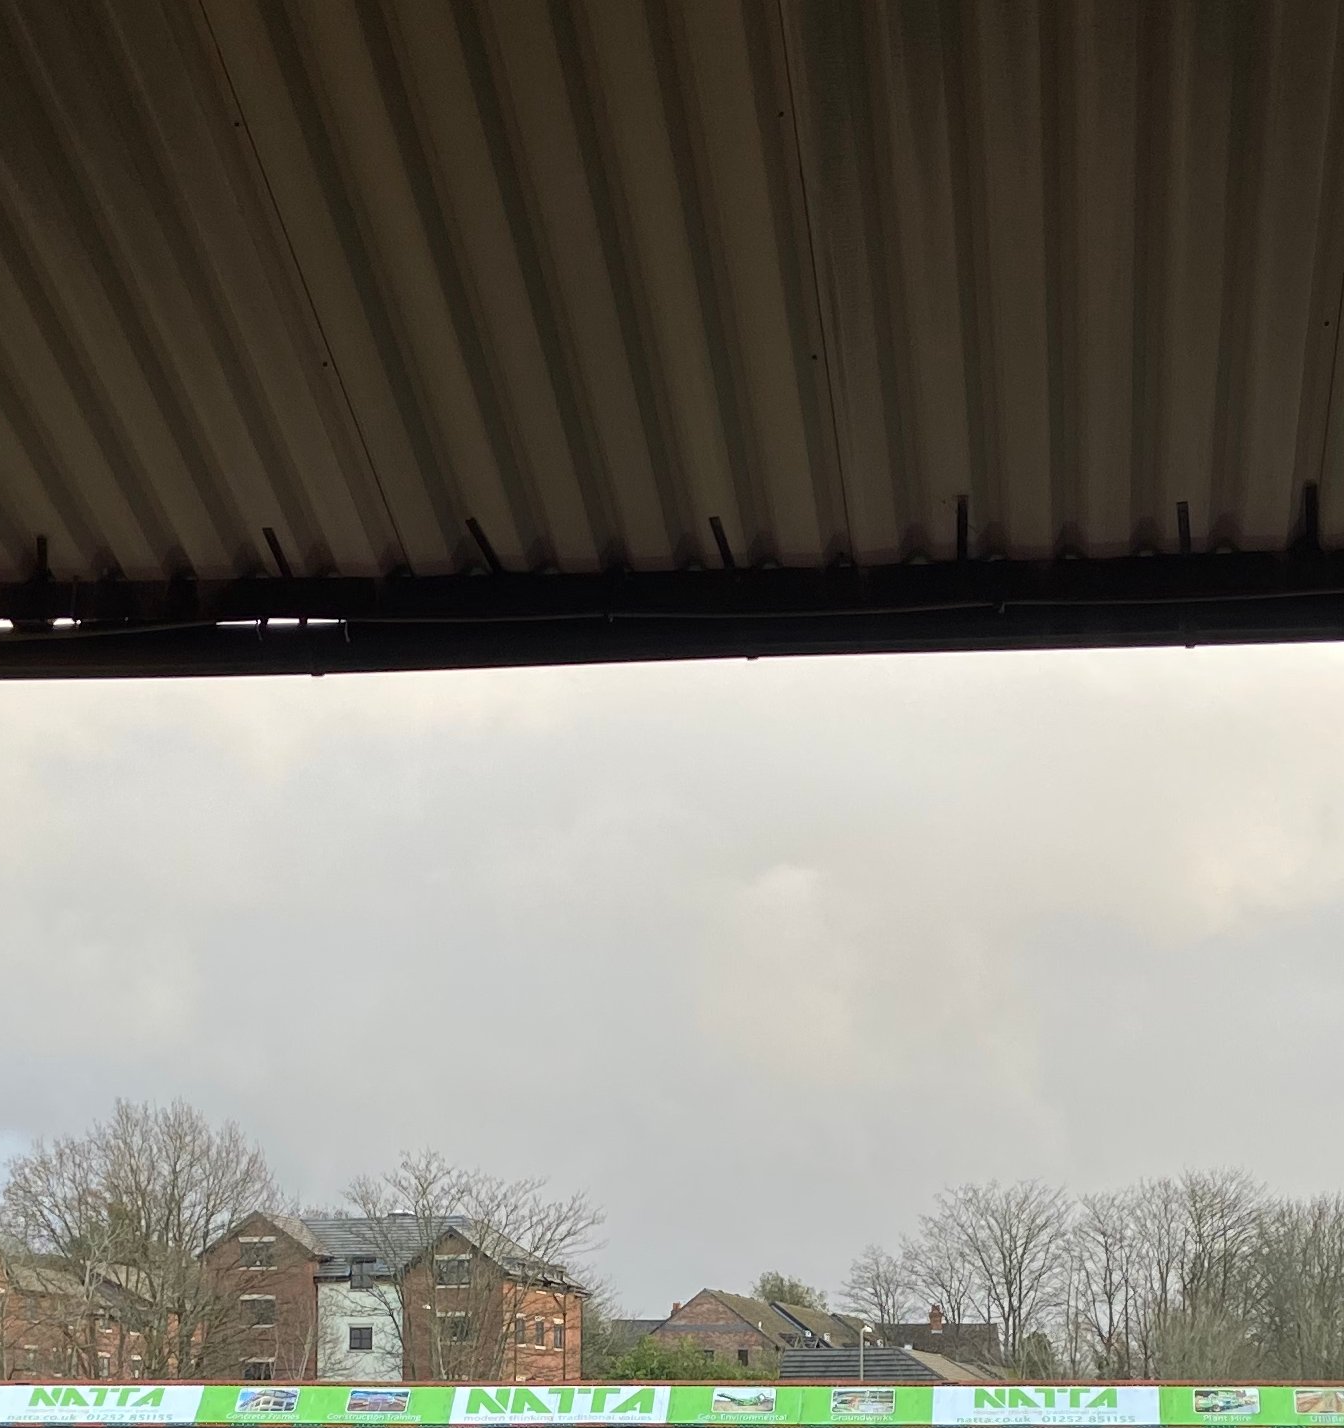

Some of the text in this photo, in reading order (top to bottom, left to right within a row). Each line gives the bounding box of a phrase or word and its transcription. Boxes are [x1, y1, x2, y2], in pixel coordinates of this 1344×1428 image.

[28, 1387, 166, 1407] NATTA
[465, 1387, 656, 1414] NATTA
[974, 1388, 1118, 1408] NATTA
[7, 1413, 77, 1421] natta.co.uk
[86, 1413, 125, 1421] 01252
[226, 1412, 267, 1421] Concrete
[327, 1412, 422, 1422] Construction Training
[463, 1414, 506, 1422] modern
[509, 1414, 554, 1422] thinking
[697, 1413, 788, 1421] Geo Environmental
[830, 1413, 894, 1421] Groundworks
[1041, 1415, 1082, 1423] 01252
[1088, 1415, 1136, 1423] 851155
